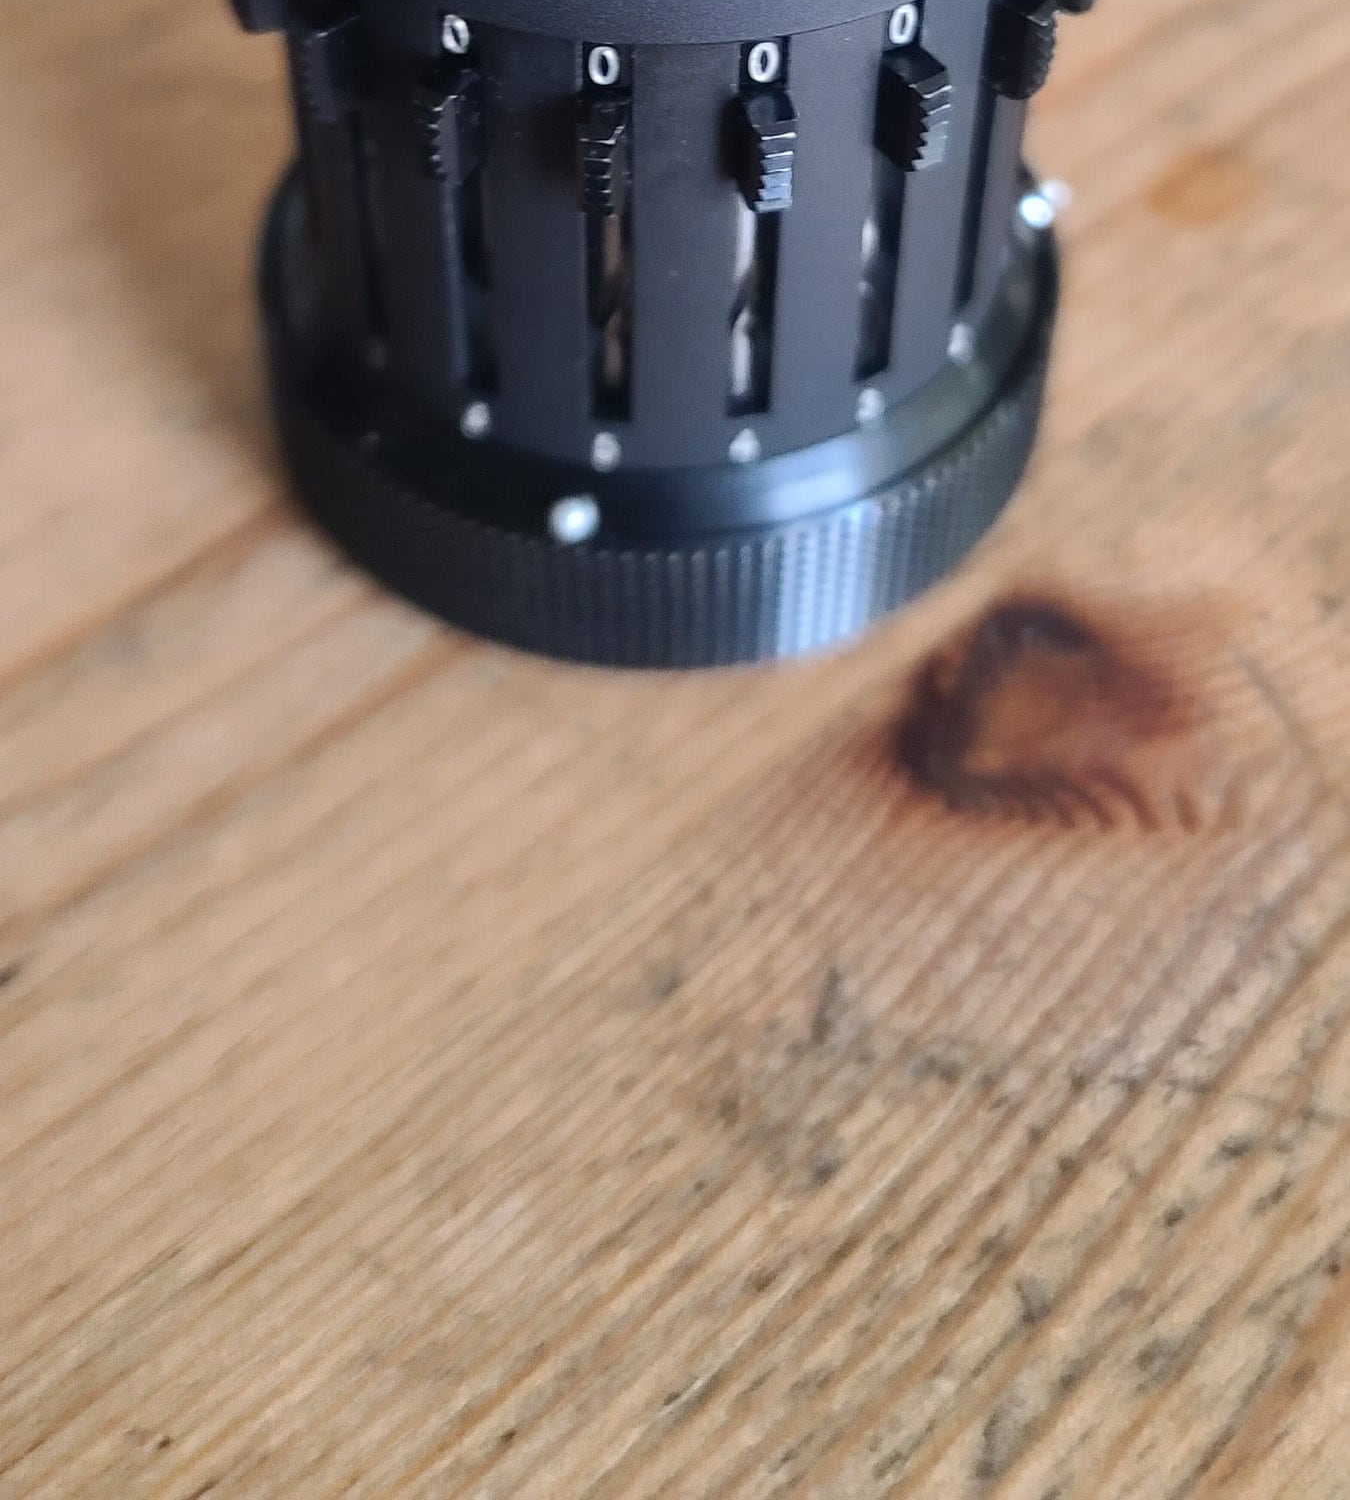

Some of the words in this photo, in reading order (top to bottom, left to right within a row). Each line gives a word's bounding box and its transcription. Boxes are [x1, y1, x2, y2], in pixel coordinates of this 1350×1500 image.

[442, 14, 470, 54] 0
[588, 46, 620, 85] 0
[747, 42, 780, 83] 0
[888, 3, 918, 45] 0
